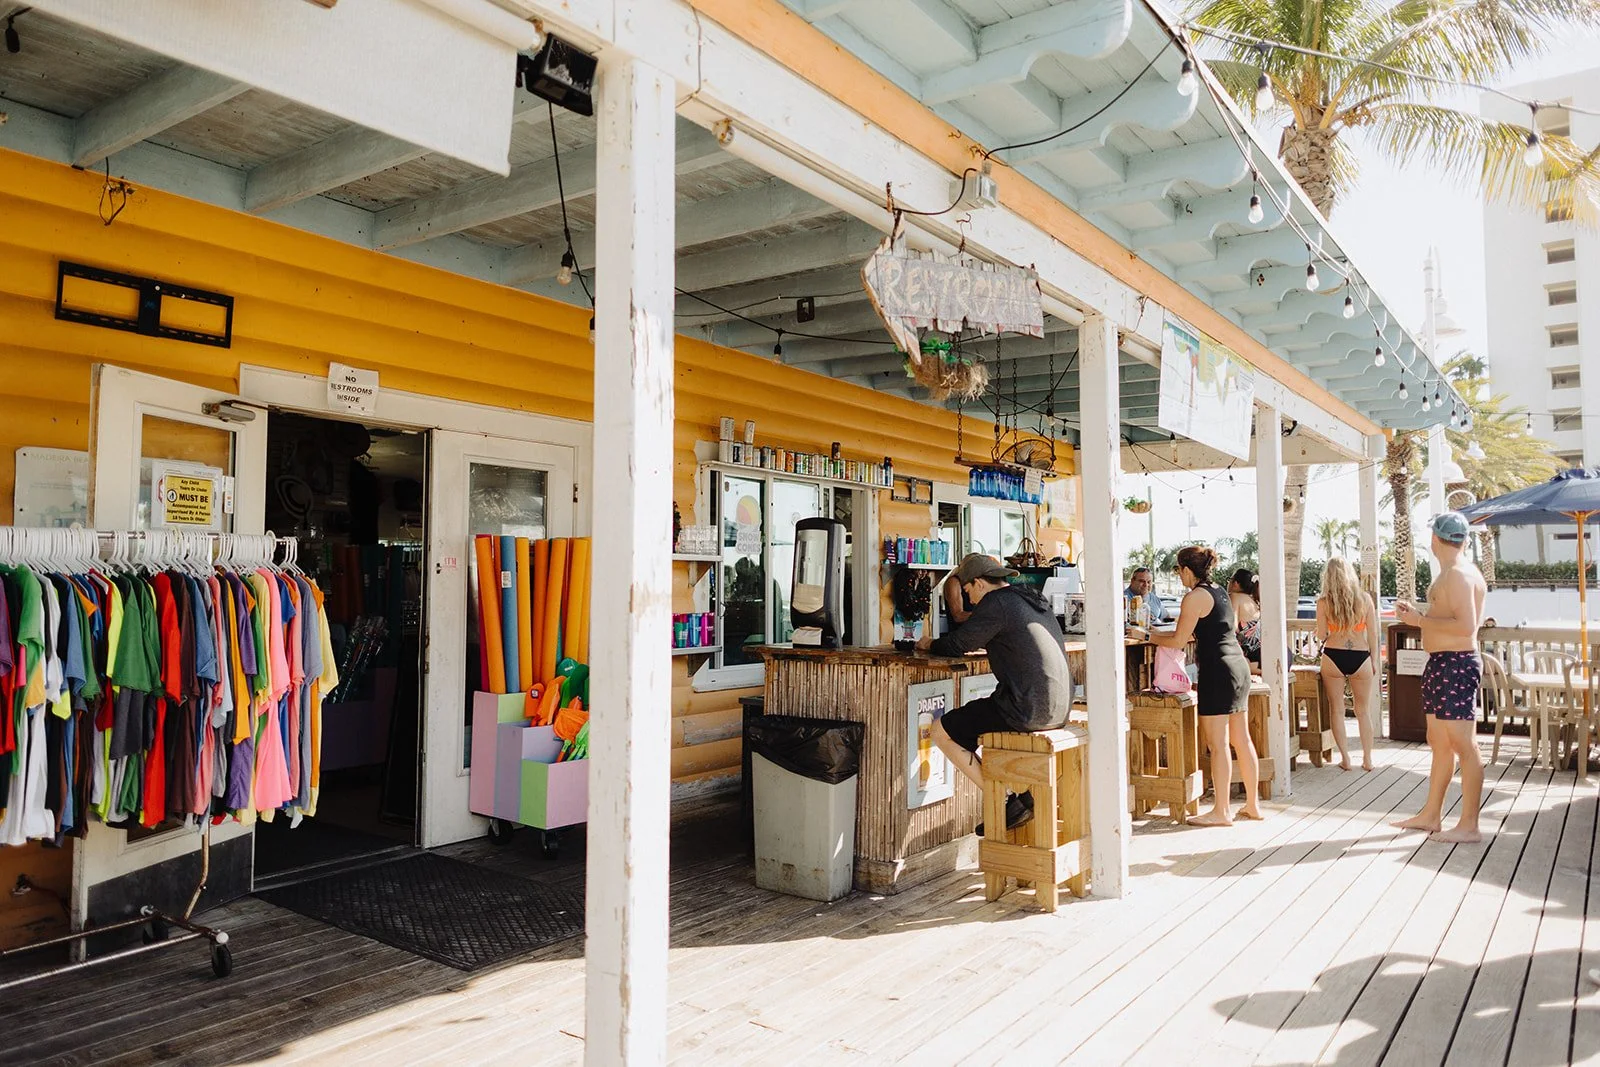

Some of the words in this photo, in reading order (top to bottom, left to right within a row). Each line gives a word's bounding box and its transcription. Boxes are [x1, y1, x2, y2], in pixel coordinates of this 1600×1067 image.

[337, 394, 360, 403] INSIDE
[31, 453, 71, 462] MADEIRA
[179, 494, 198, 502] MUST
[200, 495, 209, 503] BE
[737, 543, 761, 552] CONES
[918, 695, 945, 713] DRAFTS
